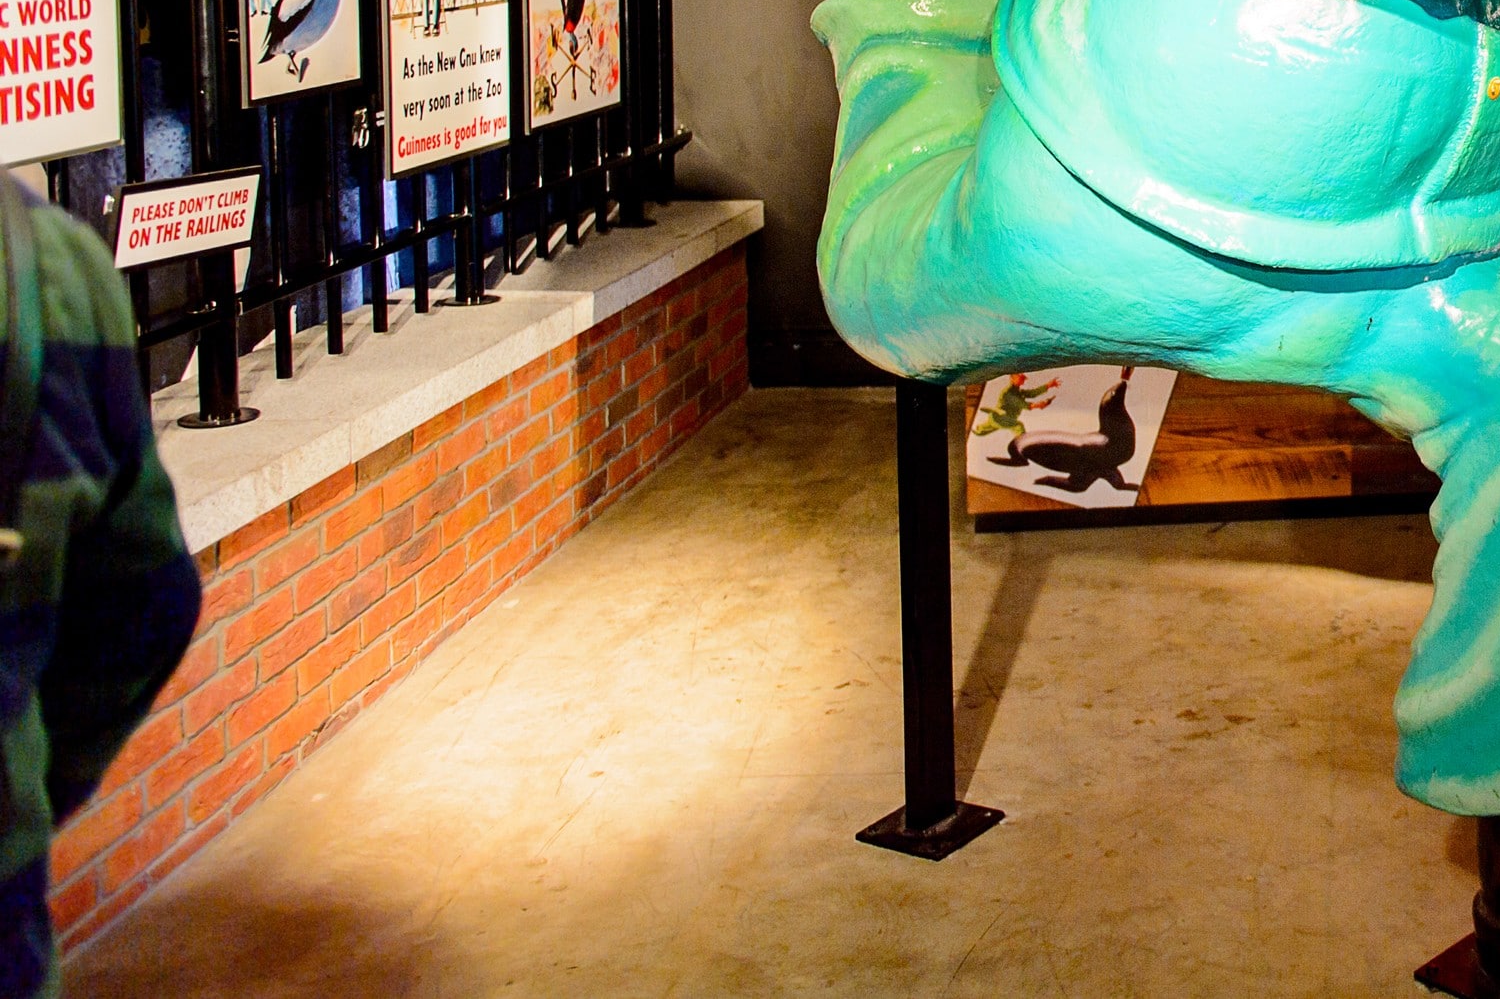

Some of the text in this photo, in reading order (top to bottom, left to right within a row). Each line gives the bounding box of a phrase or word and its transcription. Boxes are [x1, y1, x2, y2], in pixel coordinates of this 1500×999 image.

[403, 44, 502, 79] As the New Gnu knew
[403, 78, 502, 121] very soon at the Zoo
[398, 115, 507, 158] Guinness is good for you
[132, 189, 249, 224] PLEASE DON'T CLIMB
[129, 209, 246, 250] ON THE RAILINGS
